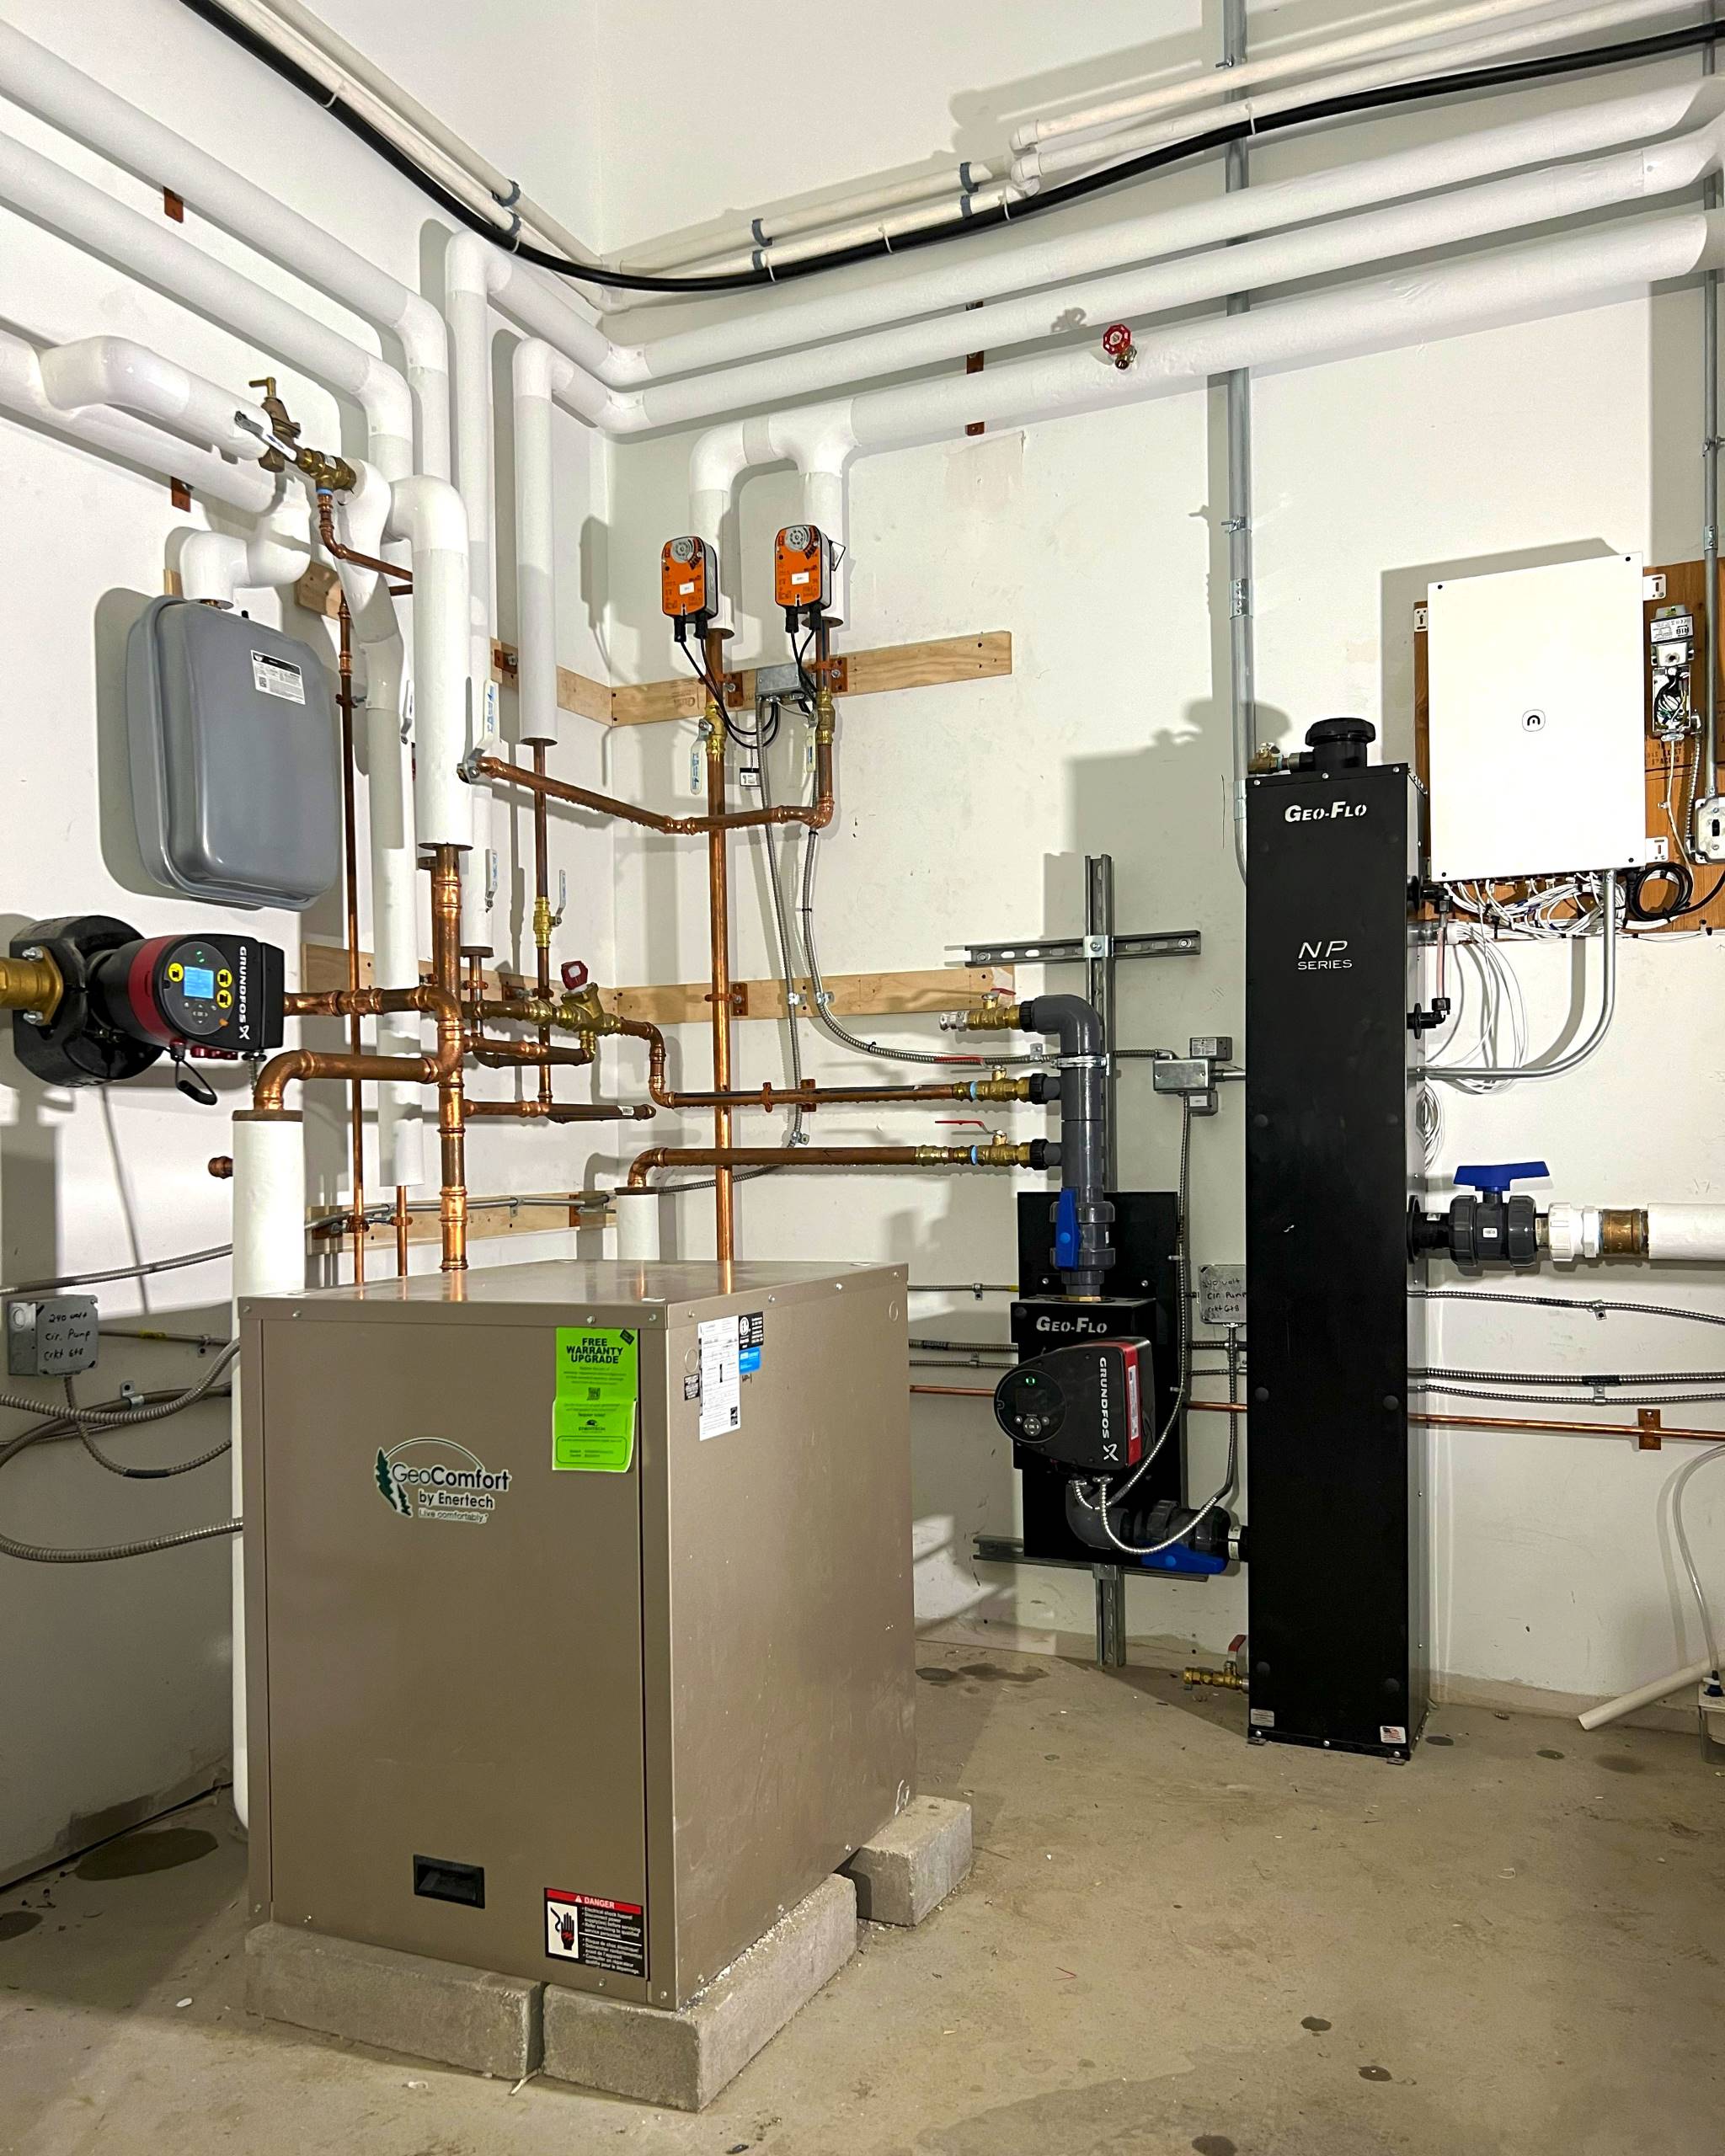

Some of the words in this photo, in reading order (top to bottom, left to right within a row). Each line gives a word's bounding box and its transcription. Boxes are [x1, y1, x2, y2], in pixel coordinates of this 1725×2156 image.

[1298, 940, 1348, 959] NP
[1297, 959, 1353, 970] SERIES
[238, 946, 248, 1023] GRUNDFOS
[48, 1314, 67, 1323] 240
[67, 1328, 91, 1342] Pump
[582, 1337, 607, 1347] FREE
[566, 1346, 623, 1356] WARRANTY
[570, 1354, 619, 1364] UPGRADE
[1099, 1357, 1110, 1439] GRUNDFOS
[392, 1463, 510, 1491] GeoComfort
[419, 1490, 434, 1506] by
[438, 1492, 494, 1509] Enertech
[419, 1508, 435, 1518] Live
[584, 1897, 615, 1908] DANGER
